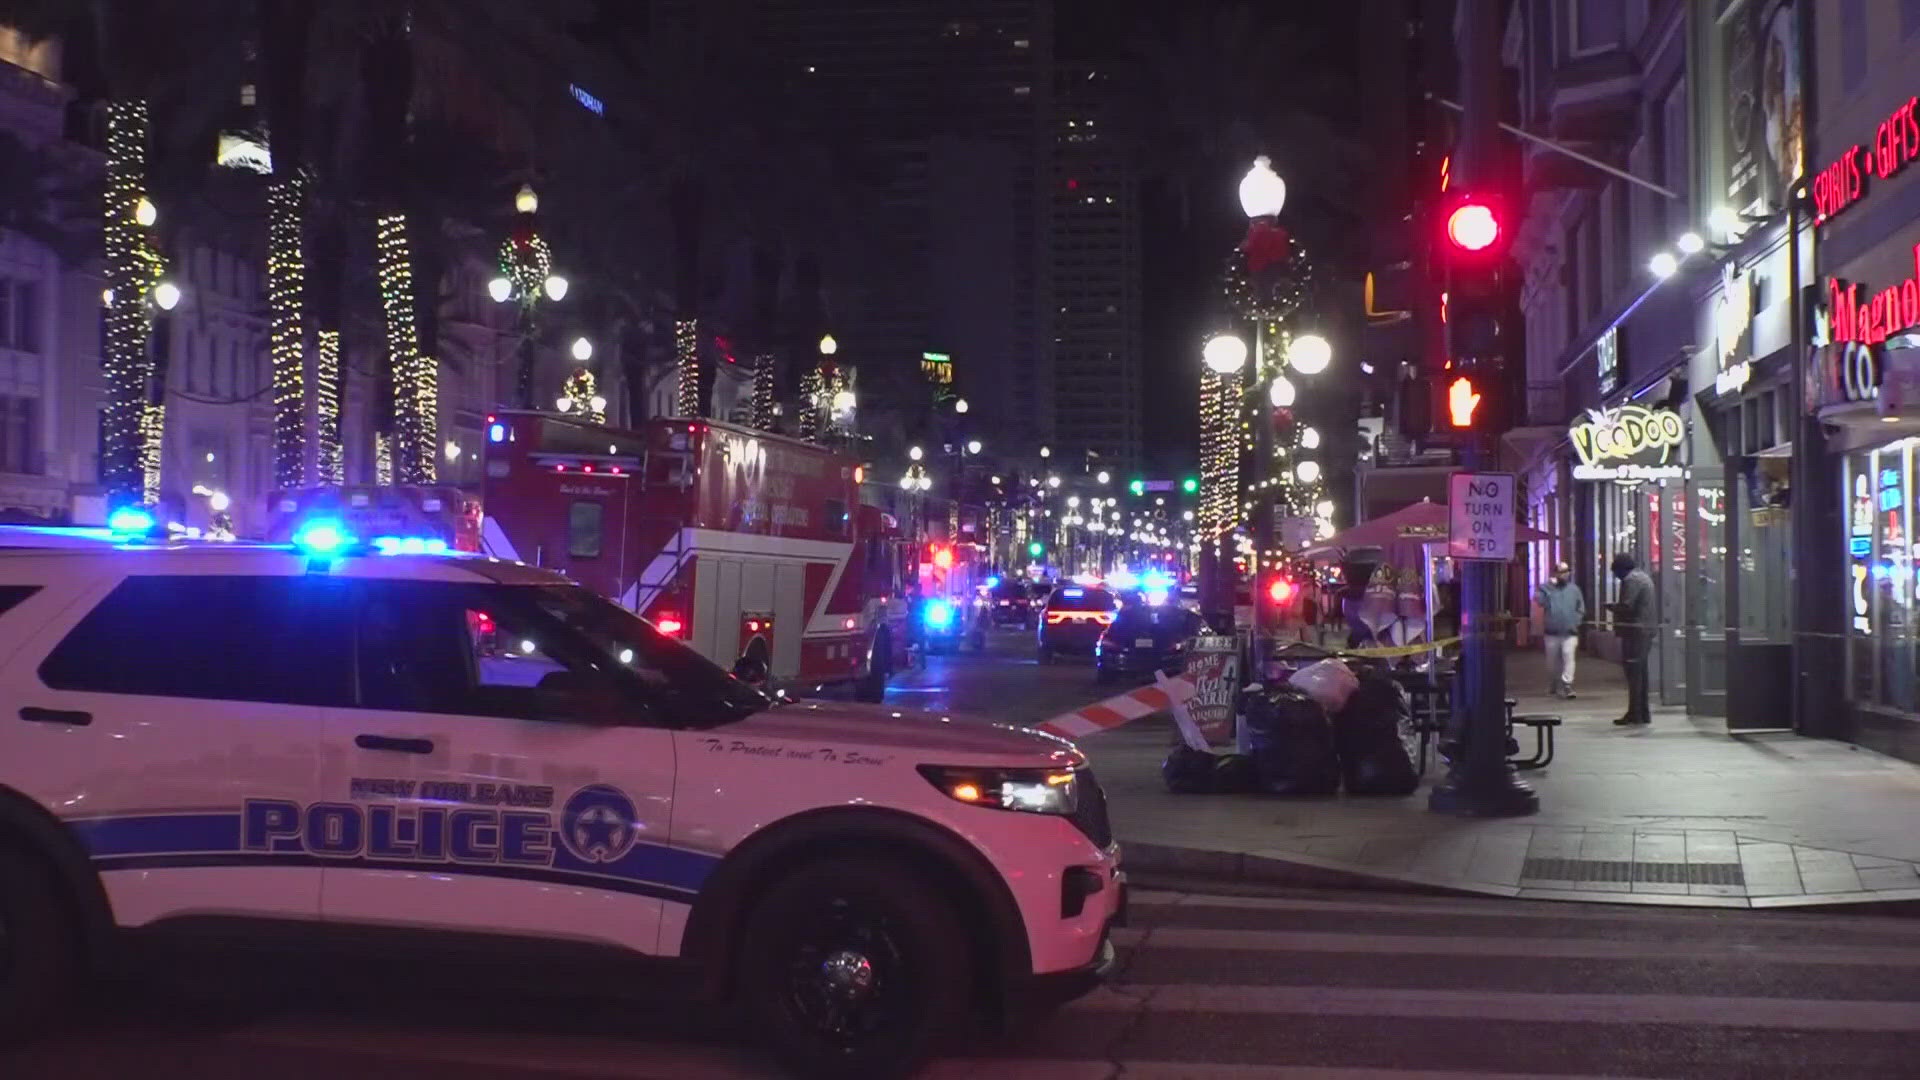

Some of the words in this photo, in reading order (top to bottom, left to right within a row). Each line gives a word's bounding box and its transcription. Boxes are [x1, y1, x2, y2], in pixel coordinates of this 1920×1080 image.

[1814, 145, 1860, 226] SPIRITS
[1876, 96, 1919, 179] GIFTS
[1569, 409, 1684, 466] VOODOO
[1469, 482, 1498, 498] NO
[1464, 503, 1503, 516] TURN
[1472, 521, 1493, 534] ON
[1467, 539, 1497, 551] RED
[351, 778, 415, 800] NEW
[420, 781, 554, 808] ORLEANS
[240, 799, 556, 868] POLICE
